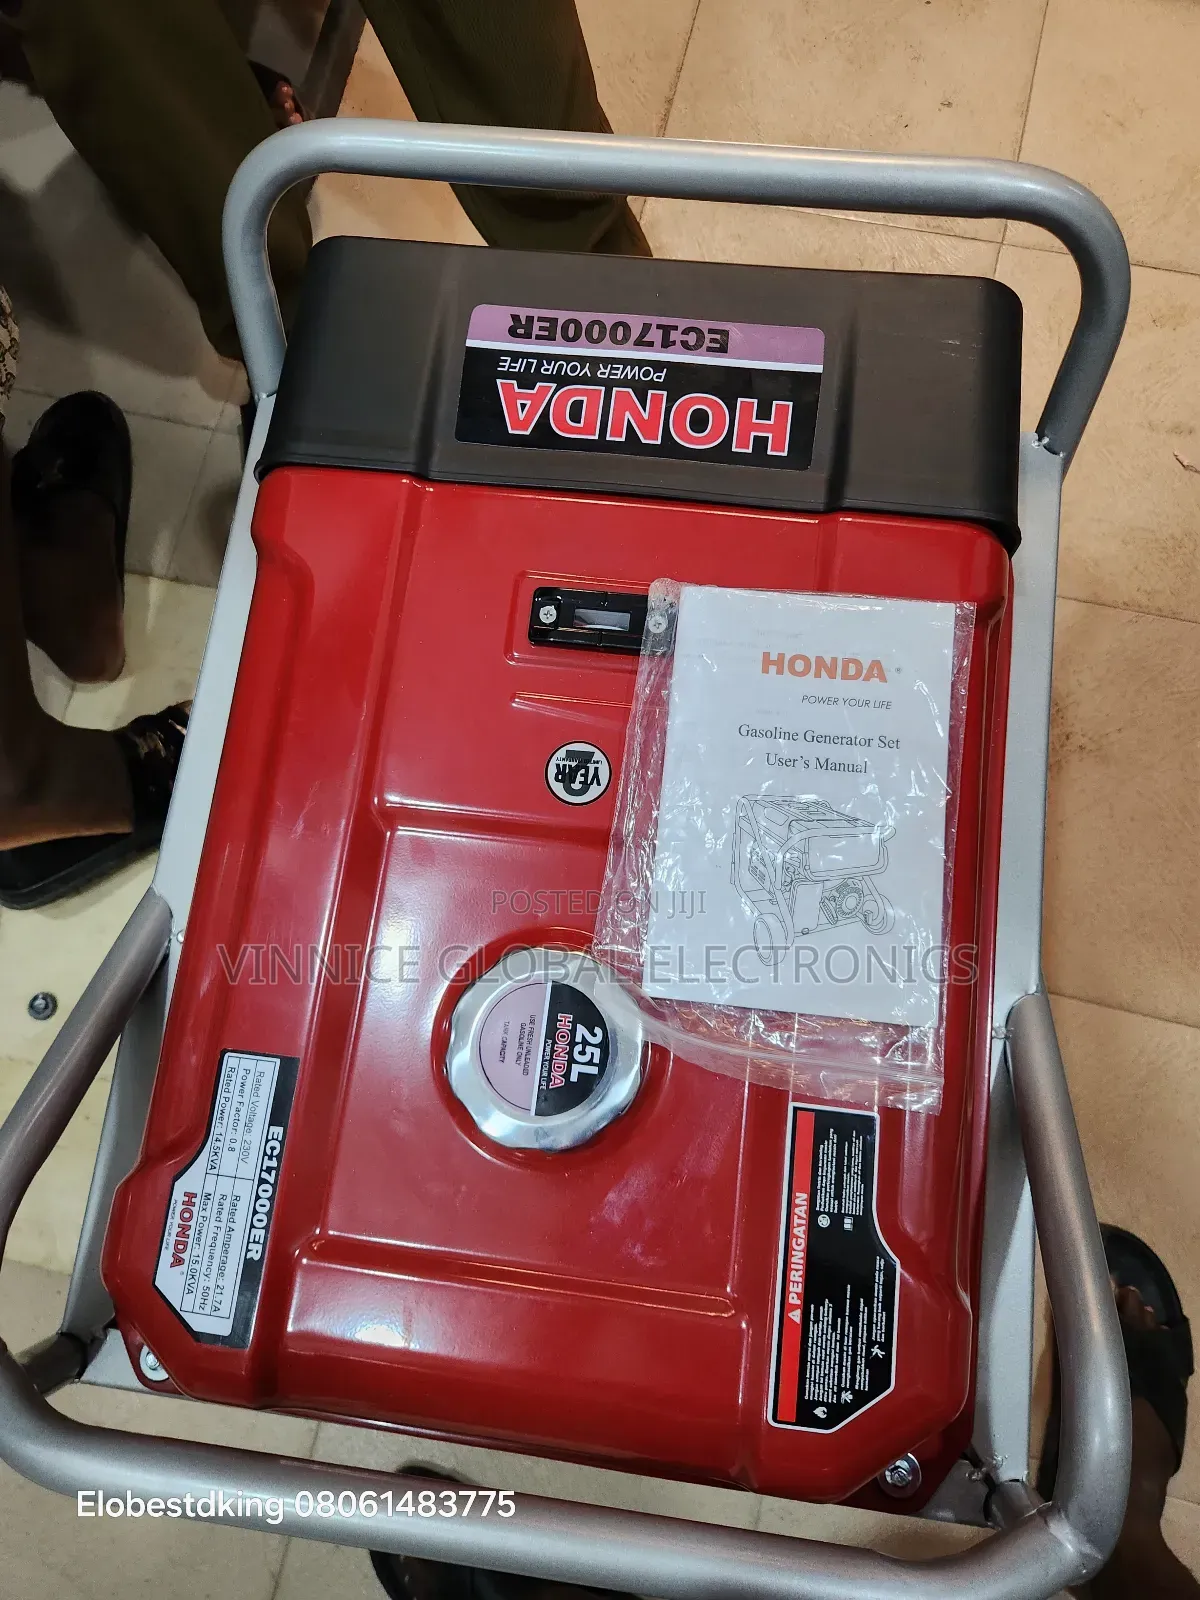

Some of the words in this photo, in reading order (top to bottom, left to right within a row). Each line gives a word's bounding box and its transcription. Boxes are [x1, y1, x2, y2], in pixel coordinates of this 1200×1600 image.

[508, 314, 730, 353] EC17000ER
[497, 356, 537, 372] LIFE
[542, 359, 592, 376] YOUR
[597, 363, 668, 382] POWER
[496, 379, 793, 456] HONDA
[761, 651, 887, 683] HONDA
[801, 695, 839, 706] POWER
[842, 697, 870, 708] YOUR
[873, 700, 892, 710] LIFE
[738, 724, 799, 741] Gasoline
[804, 730, 874, 747] Generator
[879, 736, 900, 749] Set
[554, 763, 601, 786] YEAR
[814, 757, 868, 773] Manual
[544, 1039, 552, 1060] POWER
[549, 1013, 572, 1088] HONDA
[570, 1024, 603, 1082] 25L
[222, 1066, 236, 1093] Rated
[236, 1068, 250, 1098] Power
[251, 1070, 265, 1098] Rated
[541, 1061, 549, 1077] YOUR
[216, 1096, 230, 1129] Power:
[231, 1101, 246, 1135] Factor:
[243, 1100, 259, 1136] Voltage:
[208, 1132, 224, 1171] 14.5KVA
[228, 1138, 238, 1152] 0.8
[240, 1139, 252, 1164] 230V
[200, 1192, 212, 1214] Max
[215, 1194, 228, 1223] Rated
[246, 1126, 284, 1261] EC17000ER
[229, 1194, 240, 1224] Rated
[170, 1192, 197, 1268] HONDA
[194, 1216, 208, 1250] Power:
[204, 1226, 222, 1282] Frequency:
[218, 1226, 236, 1281] Amperage:
[788, 1192, 808, 1304] PERINGATAN
[186, 1254, 200, 1295] 15.0KVA
[198, 1286, 211, 1311] 50Hz
[212, 1284, 224, 1312] 21.7A
